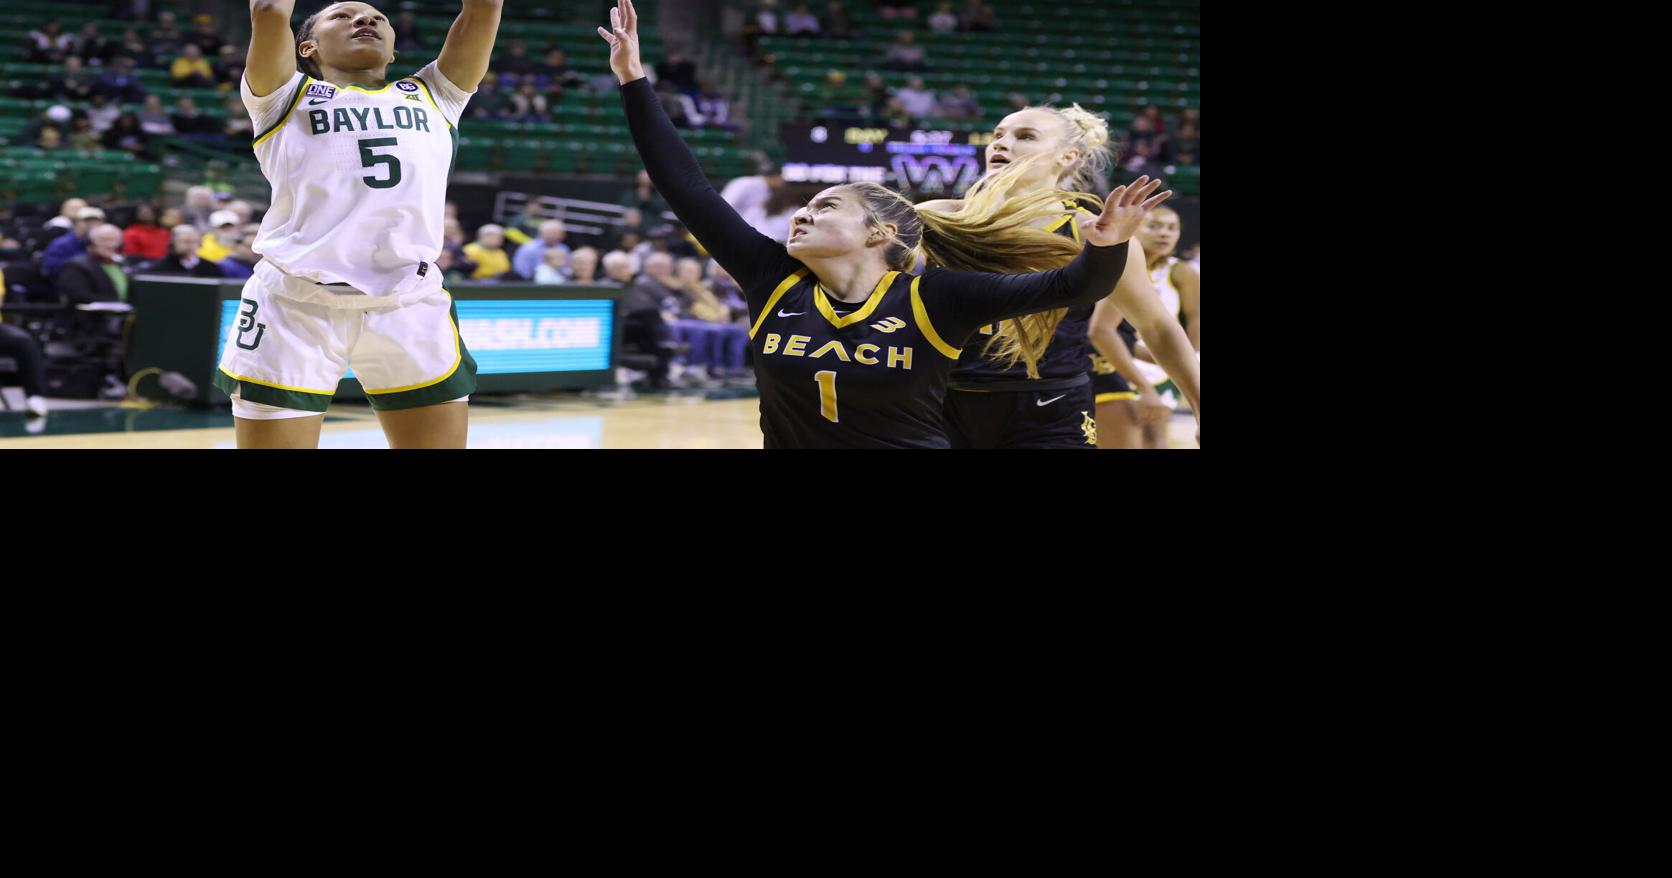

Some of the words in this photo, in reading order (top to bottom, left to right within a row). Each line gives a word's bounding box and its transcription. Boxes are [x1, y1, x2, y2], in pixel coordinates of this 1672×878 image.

[308, 84, 335, 96] ONE
[309, 106, 430, 135] BAYLOR
[358, 137, 401, 189] 5
[236, 298, 266, 351] BU
[763, 333, 913, 370] BEACH
[814, 370, 839, 423] 1
